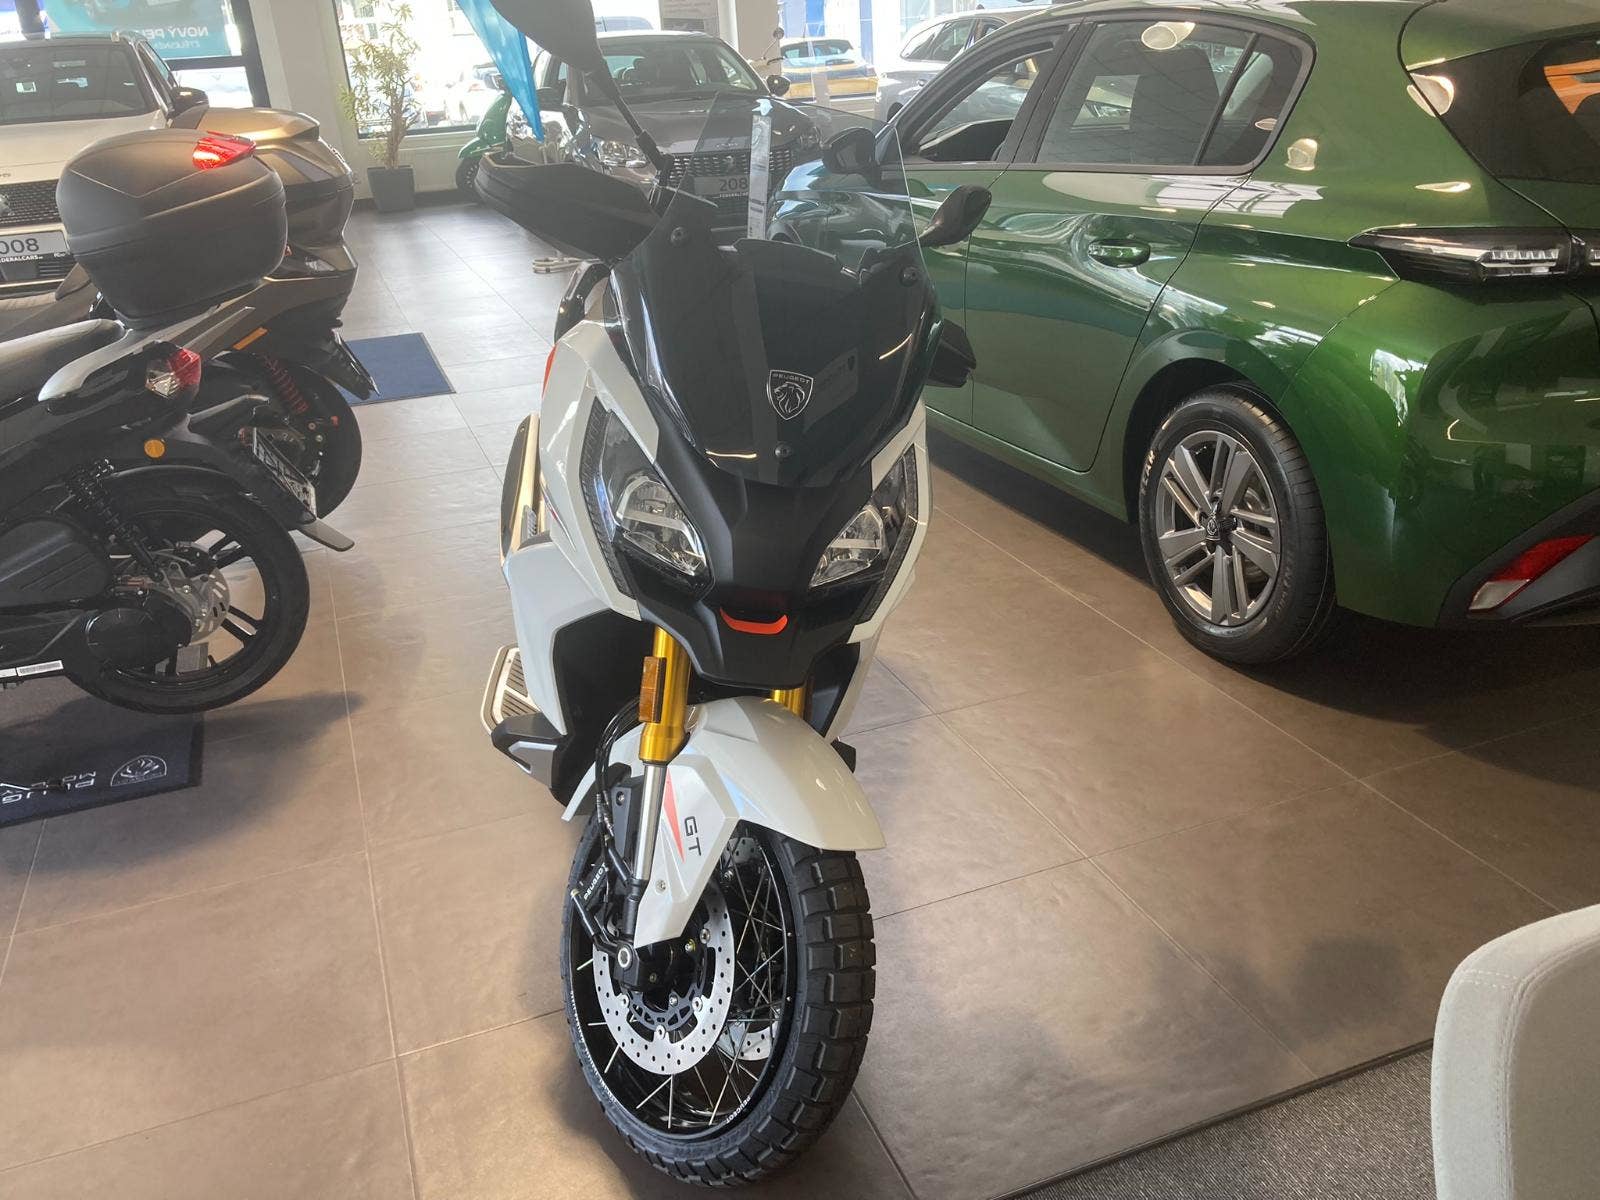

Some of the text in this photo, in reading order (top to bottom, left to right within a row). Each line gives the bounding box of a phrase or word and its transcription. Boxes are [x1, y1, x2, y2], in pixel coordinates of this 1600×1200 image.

[720, 177, 749, 192] 208
[772, 372, 811, 385] PEUGEOT
[684, 815, 702, 857] GT
[583, 861, 610, 901] PEUGEOT
[725, 1094, 752, 1124] PEUGEOT
